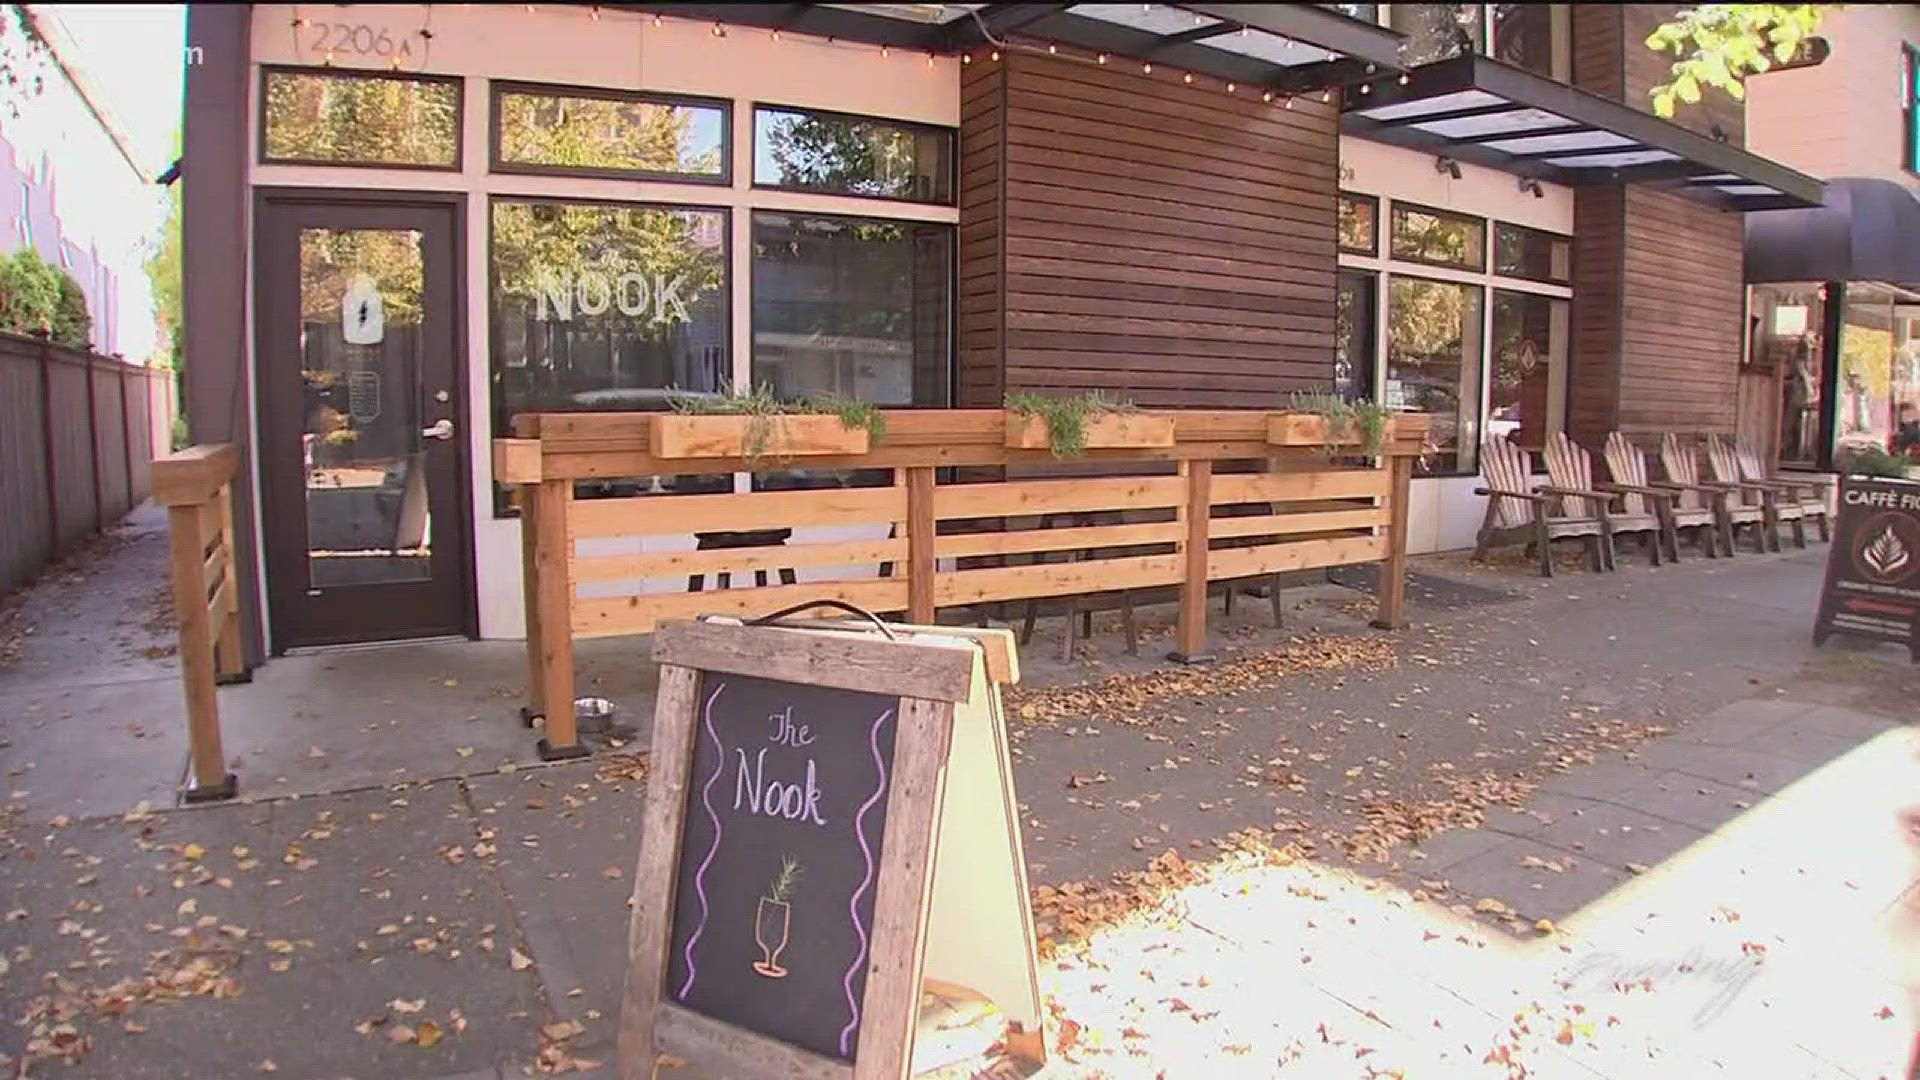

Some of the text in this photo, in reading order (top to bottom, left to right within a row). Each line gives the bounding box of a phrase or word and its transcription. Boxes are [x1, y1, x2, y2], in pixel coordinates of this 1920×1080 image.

[535, 270, 692, 323] NOOK
[768, 706, 816, 747] The
[733, 747, 826, 825] Nook
